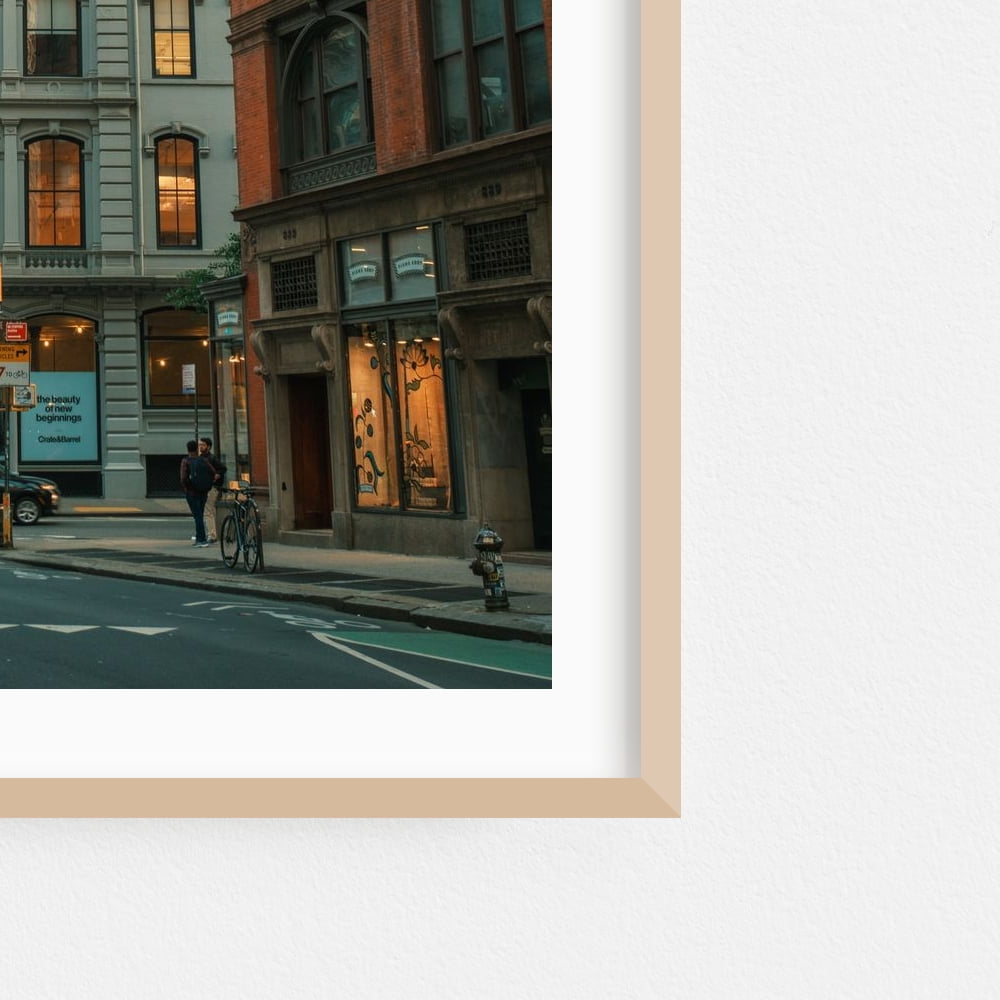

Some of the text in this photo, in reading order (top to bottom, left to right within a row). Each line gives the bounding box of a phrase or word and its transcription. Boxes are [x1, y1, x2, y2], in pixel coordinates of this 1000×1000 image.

[37, 395, 80, 405] the beauty
[36, 414, 82, 423] beginnings
